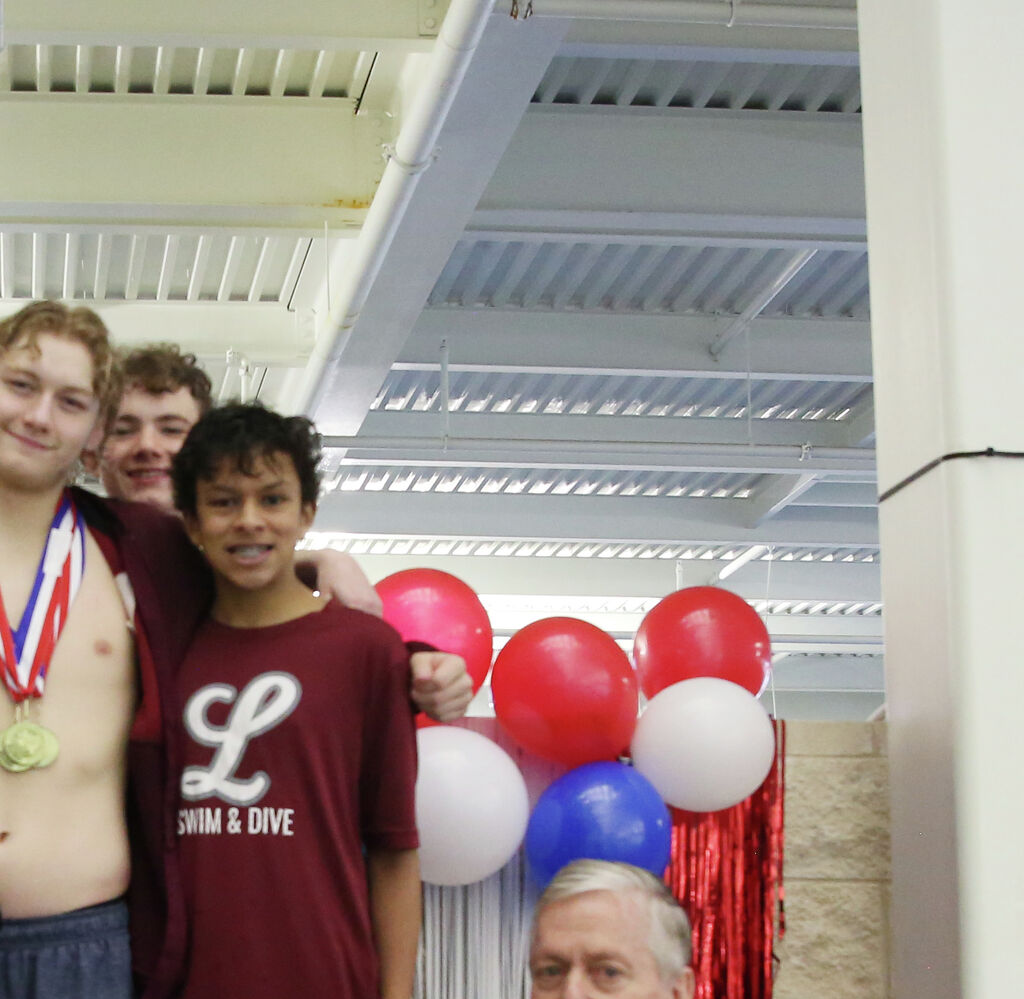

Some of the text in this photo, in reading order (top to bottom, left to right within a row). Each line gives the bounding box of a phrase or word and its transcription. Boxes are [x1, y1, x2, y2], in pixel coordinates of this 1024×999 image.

[177, 806, 295, 836] SWIM & DIVE
